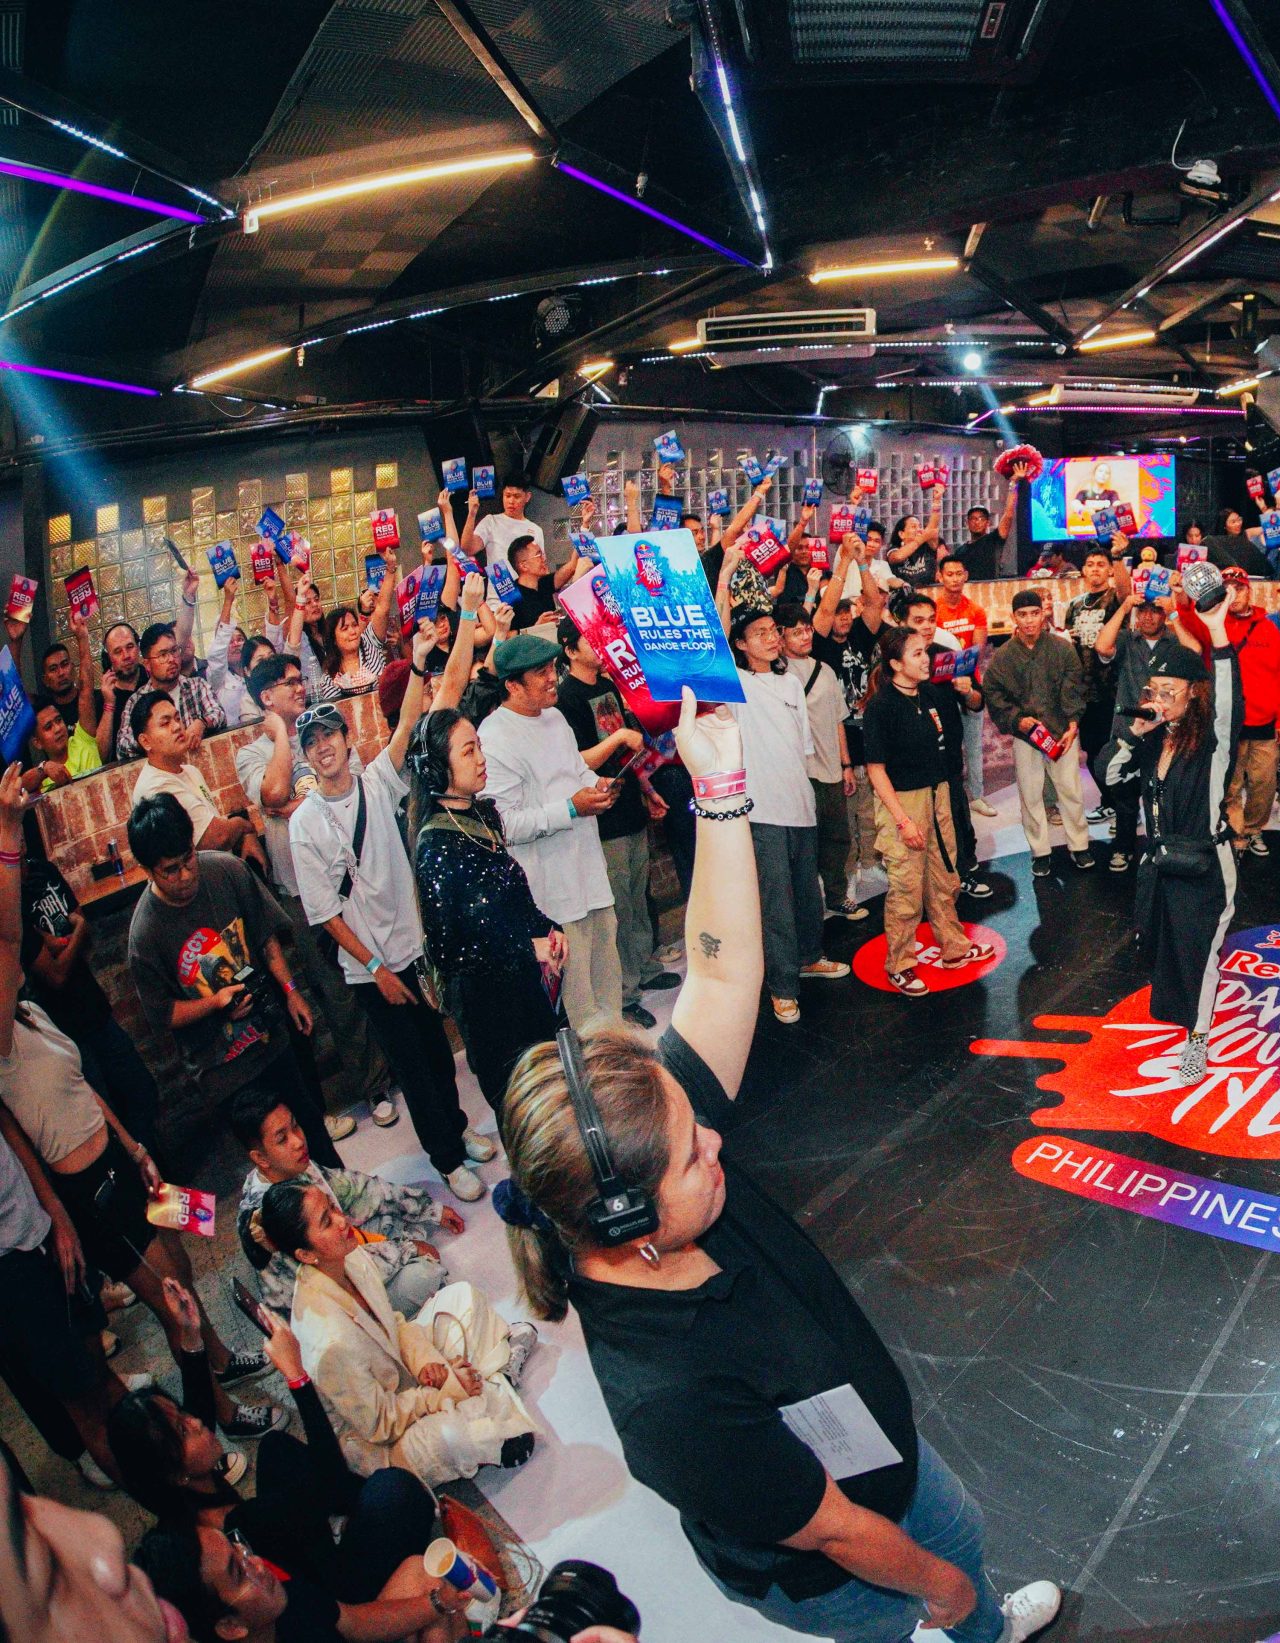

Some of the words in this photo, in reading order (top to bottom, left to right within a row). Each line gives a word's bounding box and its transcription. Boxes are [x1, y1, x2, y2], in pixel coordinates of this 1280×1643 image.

[375, 523, 394, 534] RED
[833, 519, 852, 527] RED
[751, 538, 775, 558] RED
[254, 558, 271, 566] RED
[495, 577, 513, 590] BLUE
[13, 591, 31, 603] RED
[72, 587, 91, 604] RED
[420, 591, 439, 601] BLUE
[631, 605, 707, 628] BLUE
[639, 629, 683, 640] RULES
[684, 629, 711, 639] THE
[644, 642, 679, 651] DANCE
[681, 642, 716, 651] FLOOR
[177, 1193, 190, 1225] RED
[613, 1199, 624, 1211] 6
